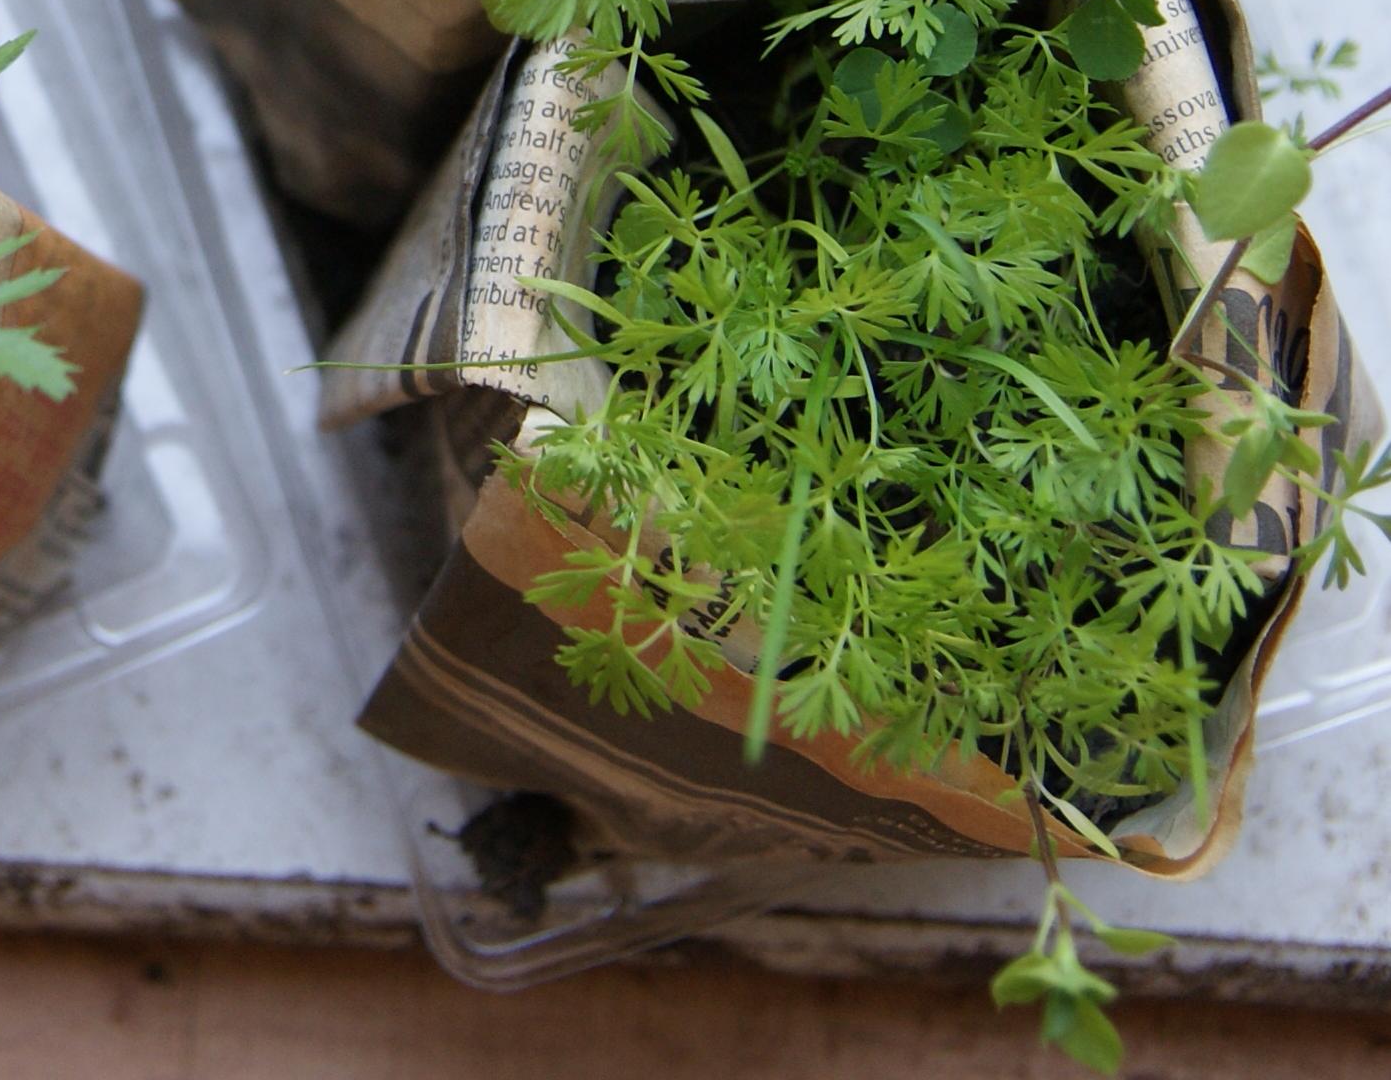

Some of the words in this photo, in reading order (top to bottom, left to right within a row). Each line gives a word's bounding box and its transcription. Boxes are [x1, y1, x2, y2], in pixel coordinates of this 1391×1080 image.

[518, 123, 567, 154] half
[568, 143, 585, 166] of
[484, 186, 566, 221] Andrew's
[512, 224, 540, 246] at
